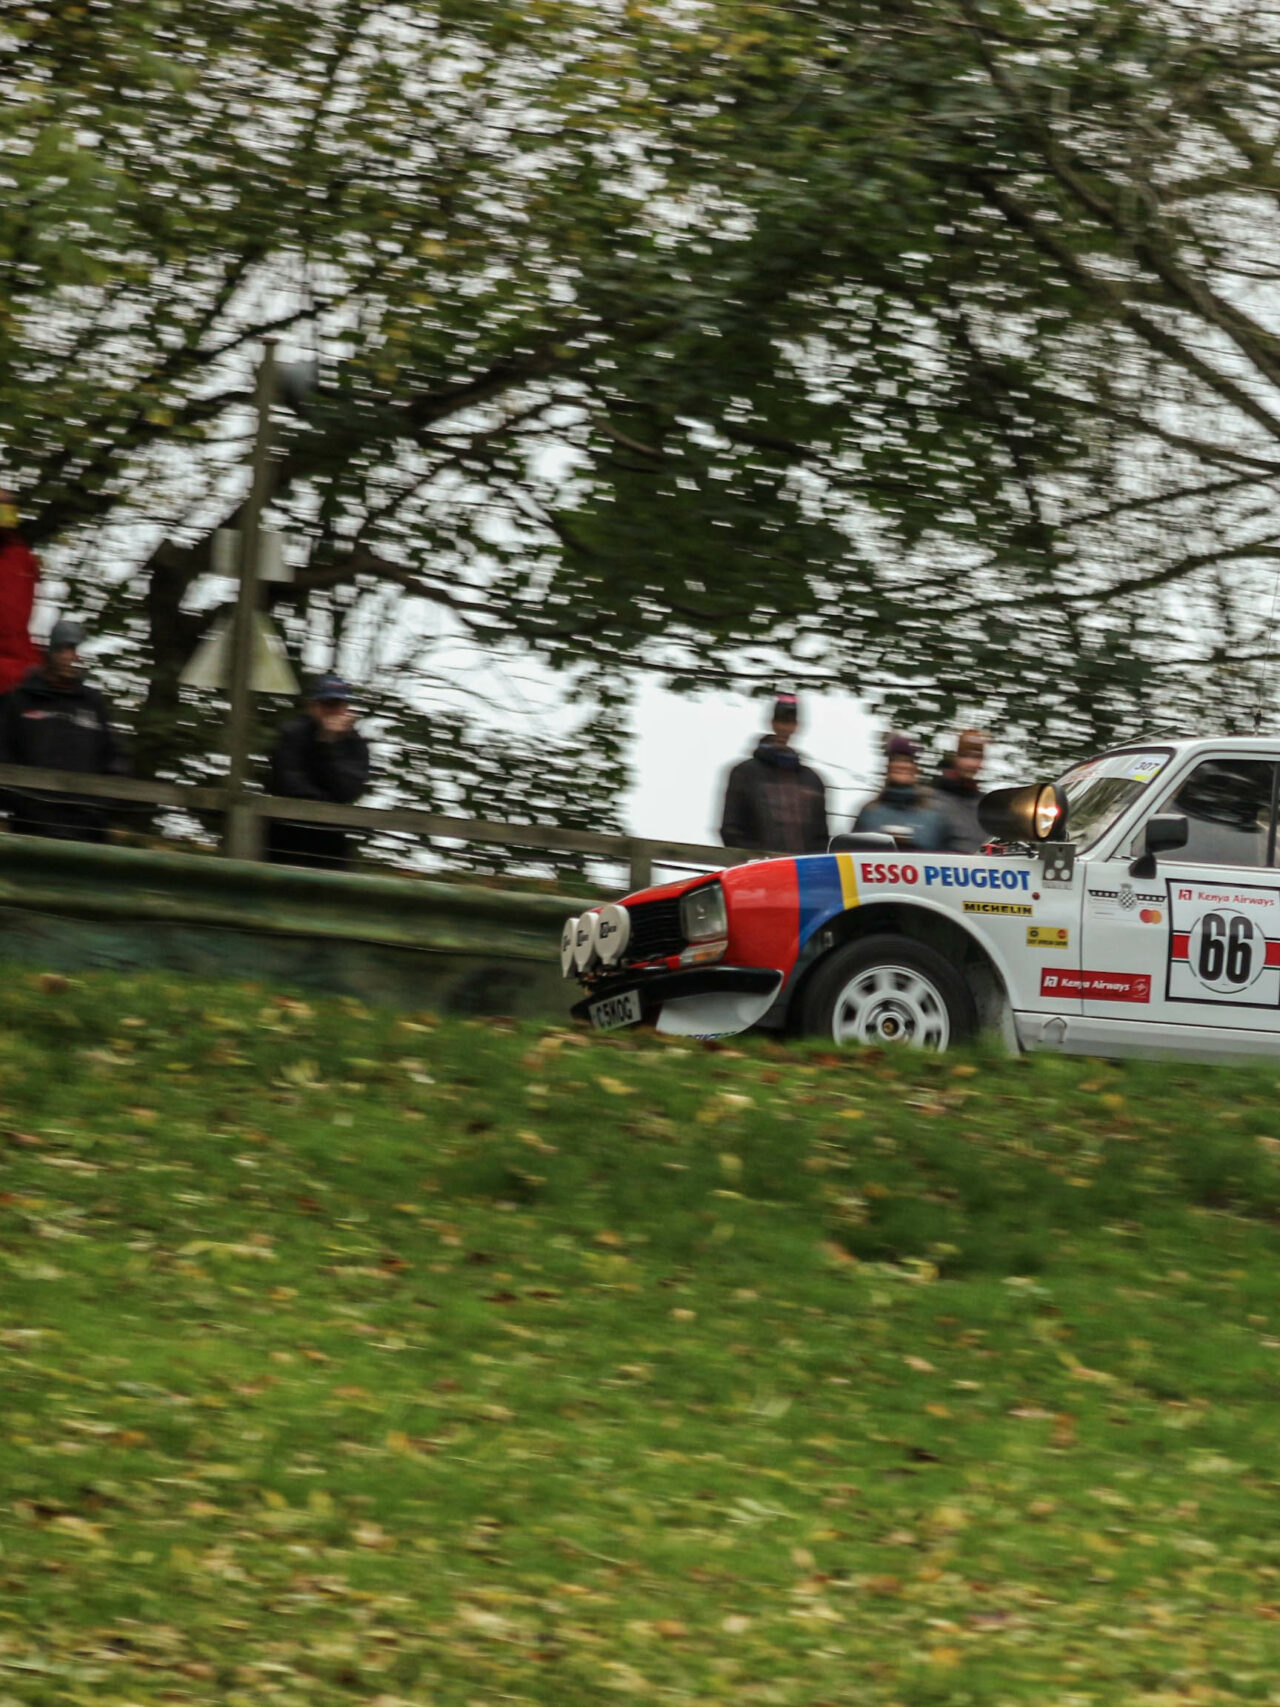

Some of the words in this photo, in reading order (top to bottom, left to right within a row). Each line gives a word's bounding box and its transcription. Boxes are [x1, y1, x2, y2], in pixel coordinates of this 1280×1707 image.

[860, 863, 919, 885] ESSO
[923, 865, 1031, 891] PEUGEOT
[1198, 891, 1230, 903] Kenya
[1232, 894, 1275, 907] Airways
[963, 903, 1032, 915] MICHELIN
[1199, 913, 1253, 984] 66
[1061, 976, 1091, 989] Kenya
[1091, 979, 1131, 992] Airways
